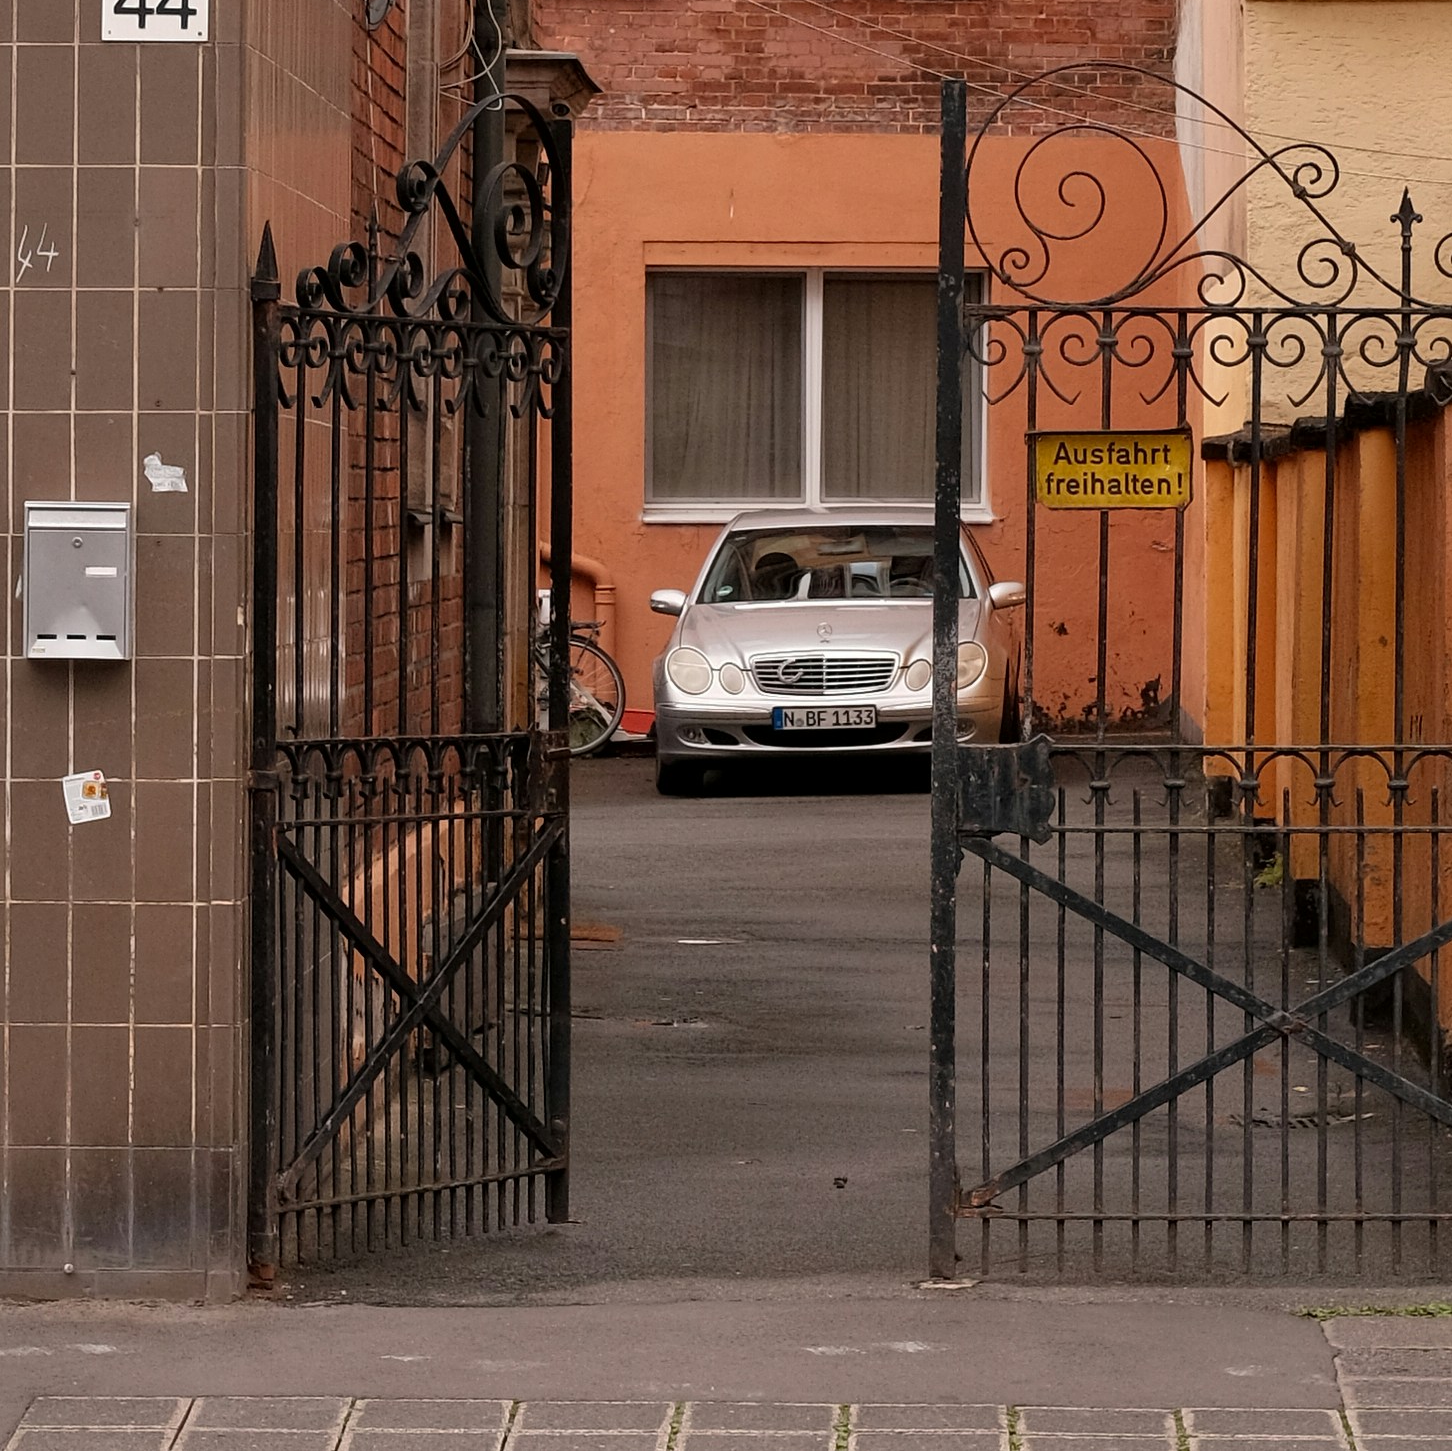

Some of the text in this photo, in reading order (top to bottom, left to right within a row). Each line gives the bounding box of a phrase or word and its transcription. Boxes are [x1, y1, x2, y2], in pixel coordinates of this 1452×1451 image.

[15, 222, 60, 284] 44
[1053, 441, 1171, 465] Ausfahrt
[1045, 471, 1183, 495] freihalten!
[806, 710, 827, 727] BF
[832, 709, 874, 727] 1133
